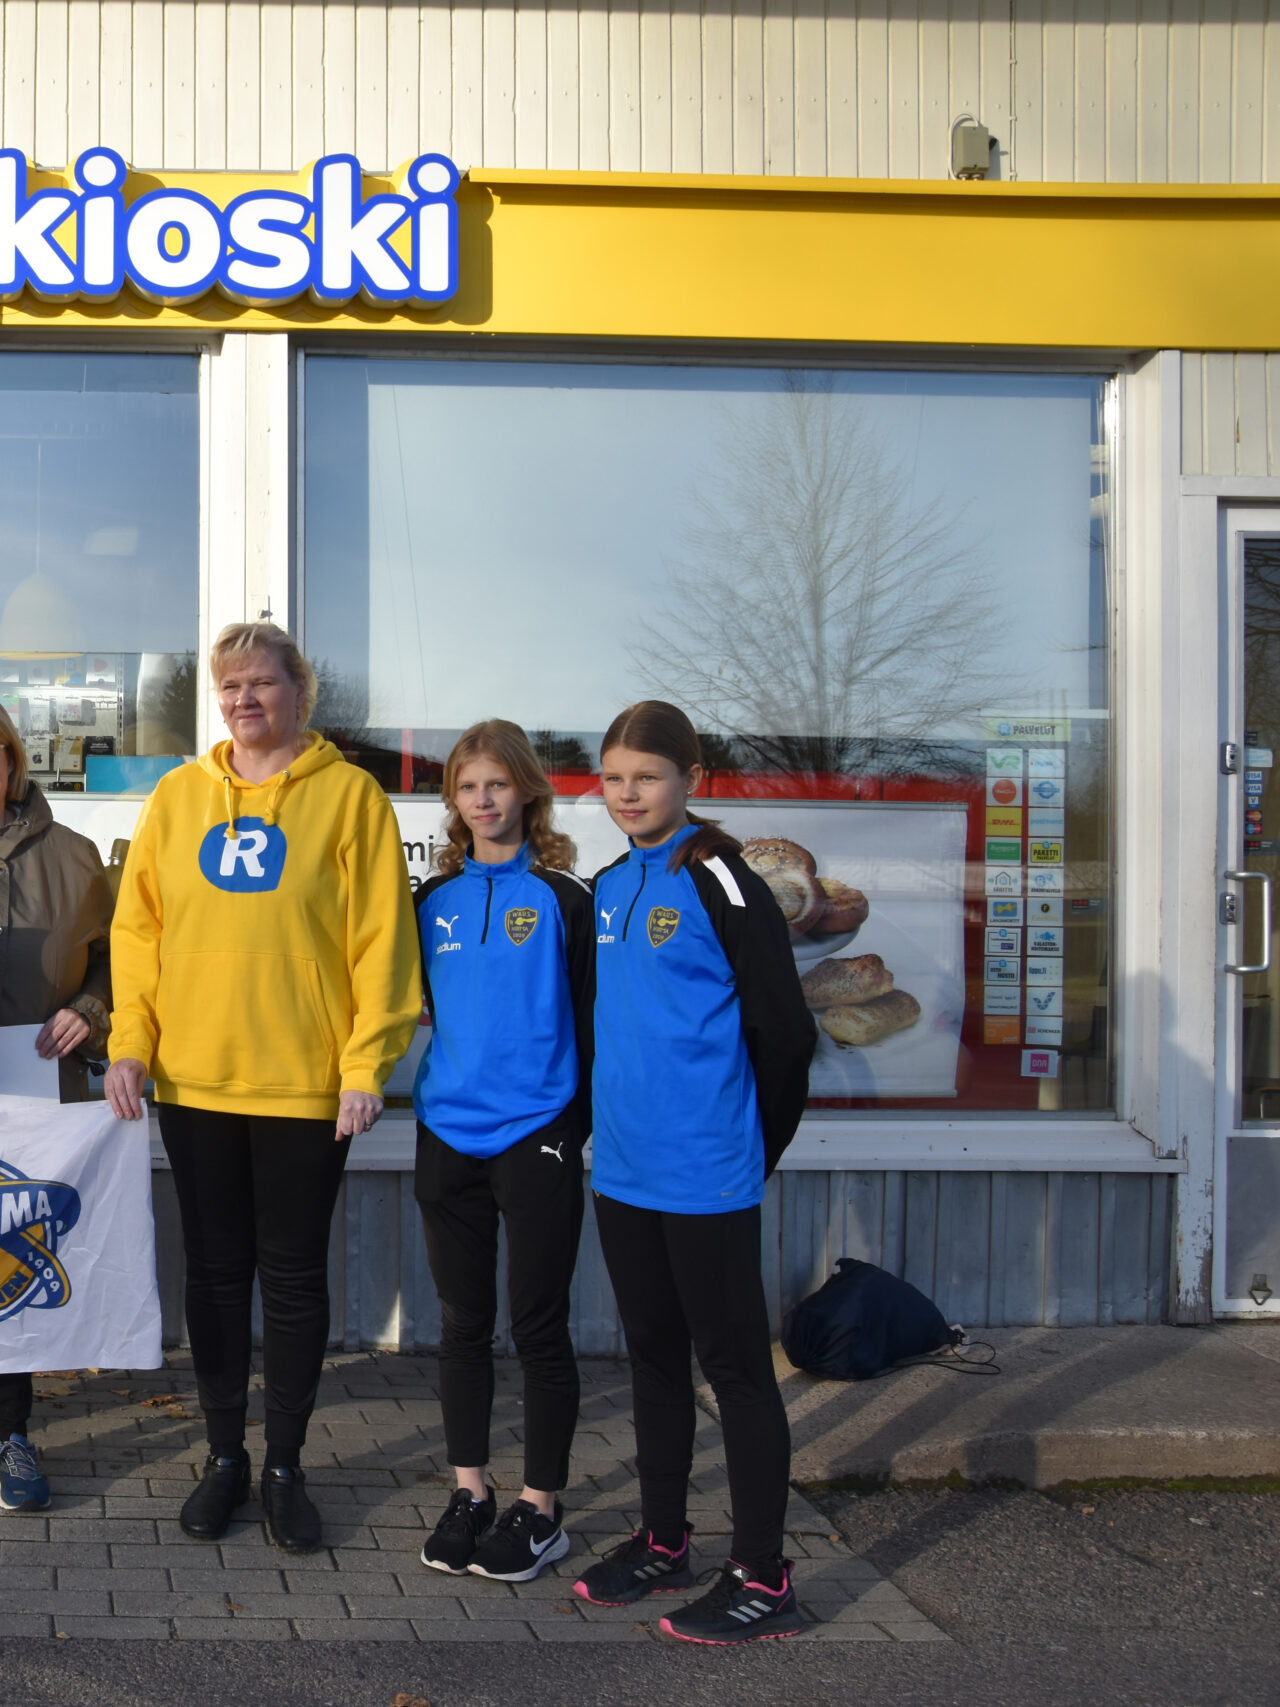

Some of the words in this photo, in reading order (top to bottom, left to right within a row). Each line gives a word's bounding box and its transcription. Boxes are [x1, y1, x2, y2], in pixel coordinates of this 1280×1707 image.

[1012, 725, 1056, 736] PALVELUT
[219, 829, 268, 878] R
[28, 1251, 61, 1292] 1909
